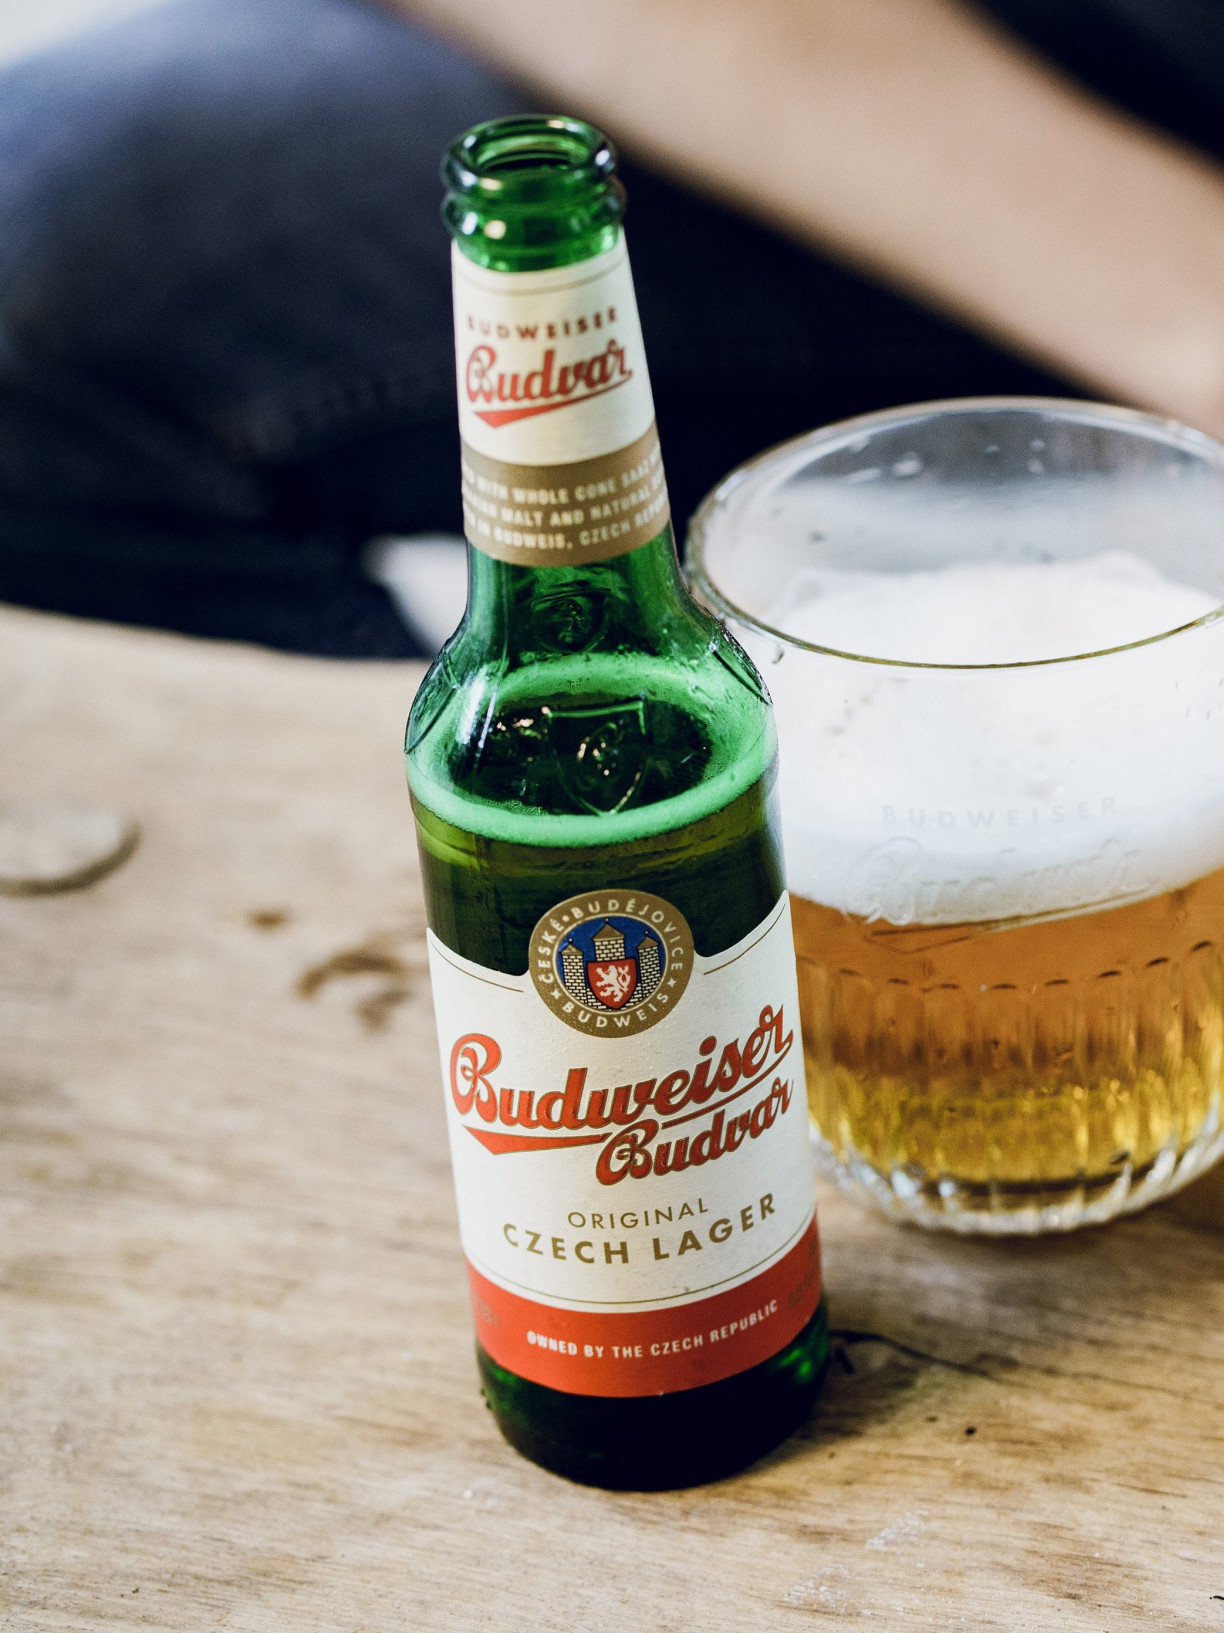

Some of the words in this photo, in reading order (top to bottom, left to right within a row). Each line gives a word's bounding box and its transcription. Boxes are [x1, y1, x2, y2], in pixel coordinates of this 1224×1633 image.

[466, 339, 633, 406] Budvar
[501, 506, 543, 527] MALT
[550, 510, 584, 526] AND
[512, 487, 569, 505] WHOLE
[881, 796, 1117, 829] BUDWEISER
[562, 991, 669, 1029] BUDWEIS
[450, 1003, 794, 1131] Budweiser
[595, 1077, 794, 1186] Budvar
[503, 1223, 630, 1265] CZECH
[652, 1193, 776, 1262] LAGER
[567, 1197, 709, 1230] ORIGINAL
[526, 1330, 578, 1356] OWNED
[584, 1344, 604, 1359] BY
[612, 1345, 643, 1359] THE
[651, 1334, 704, 1357] CZECH
[710, 1299, 778, 1343] REPUBLIC
